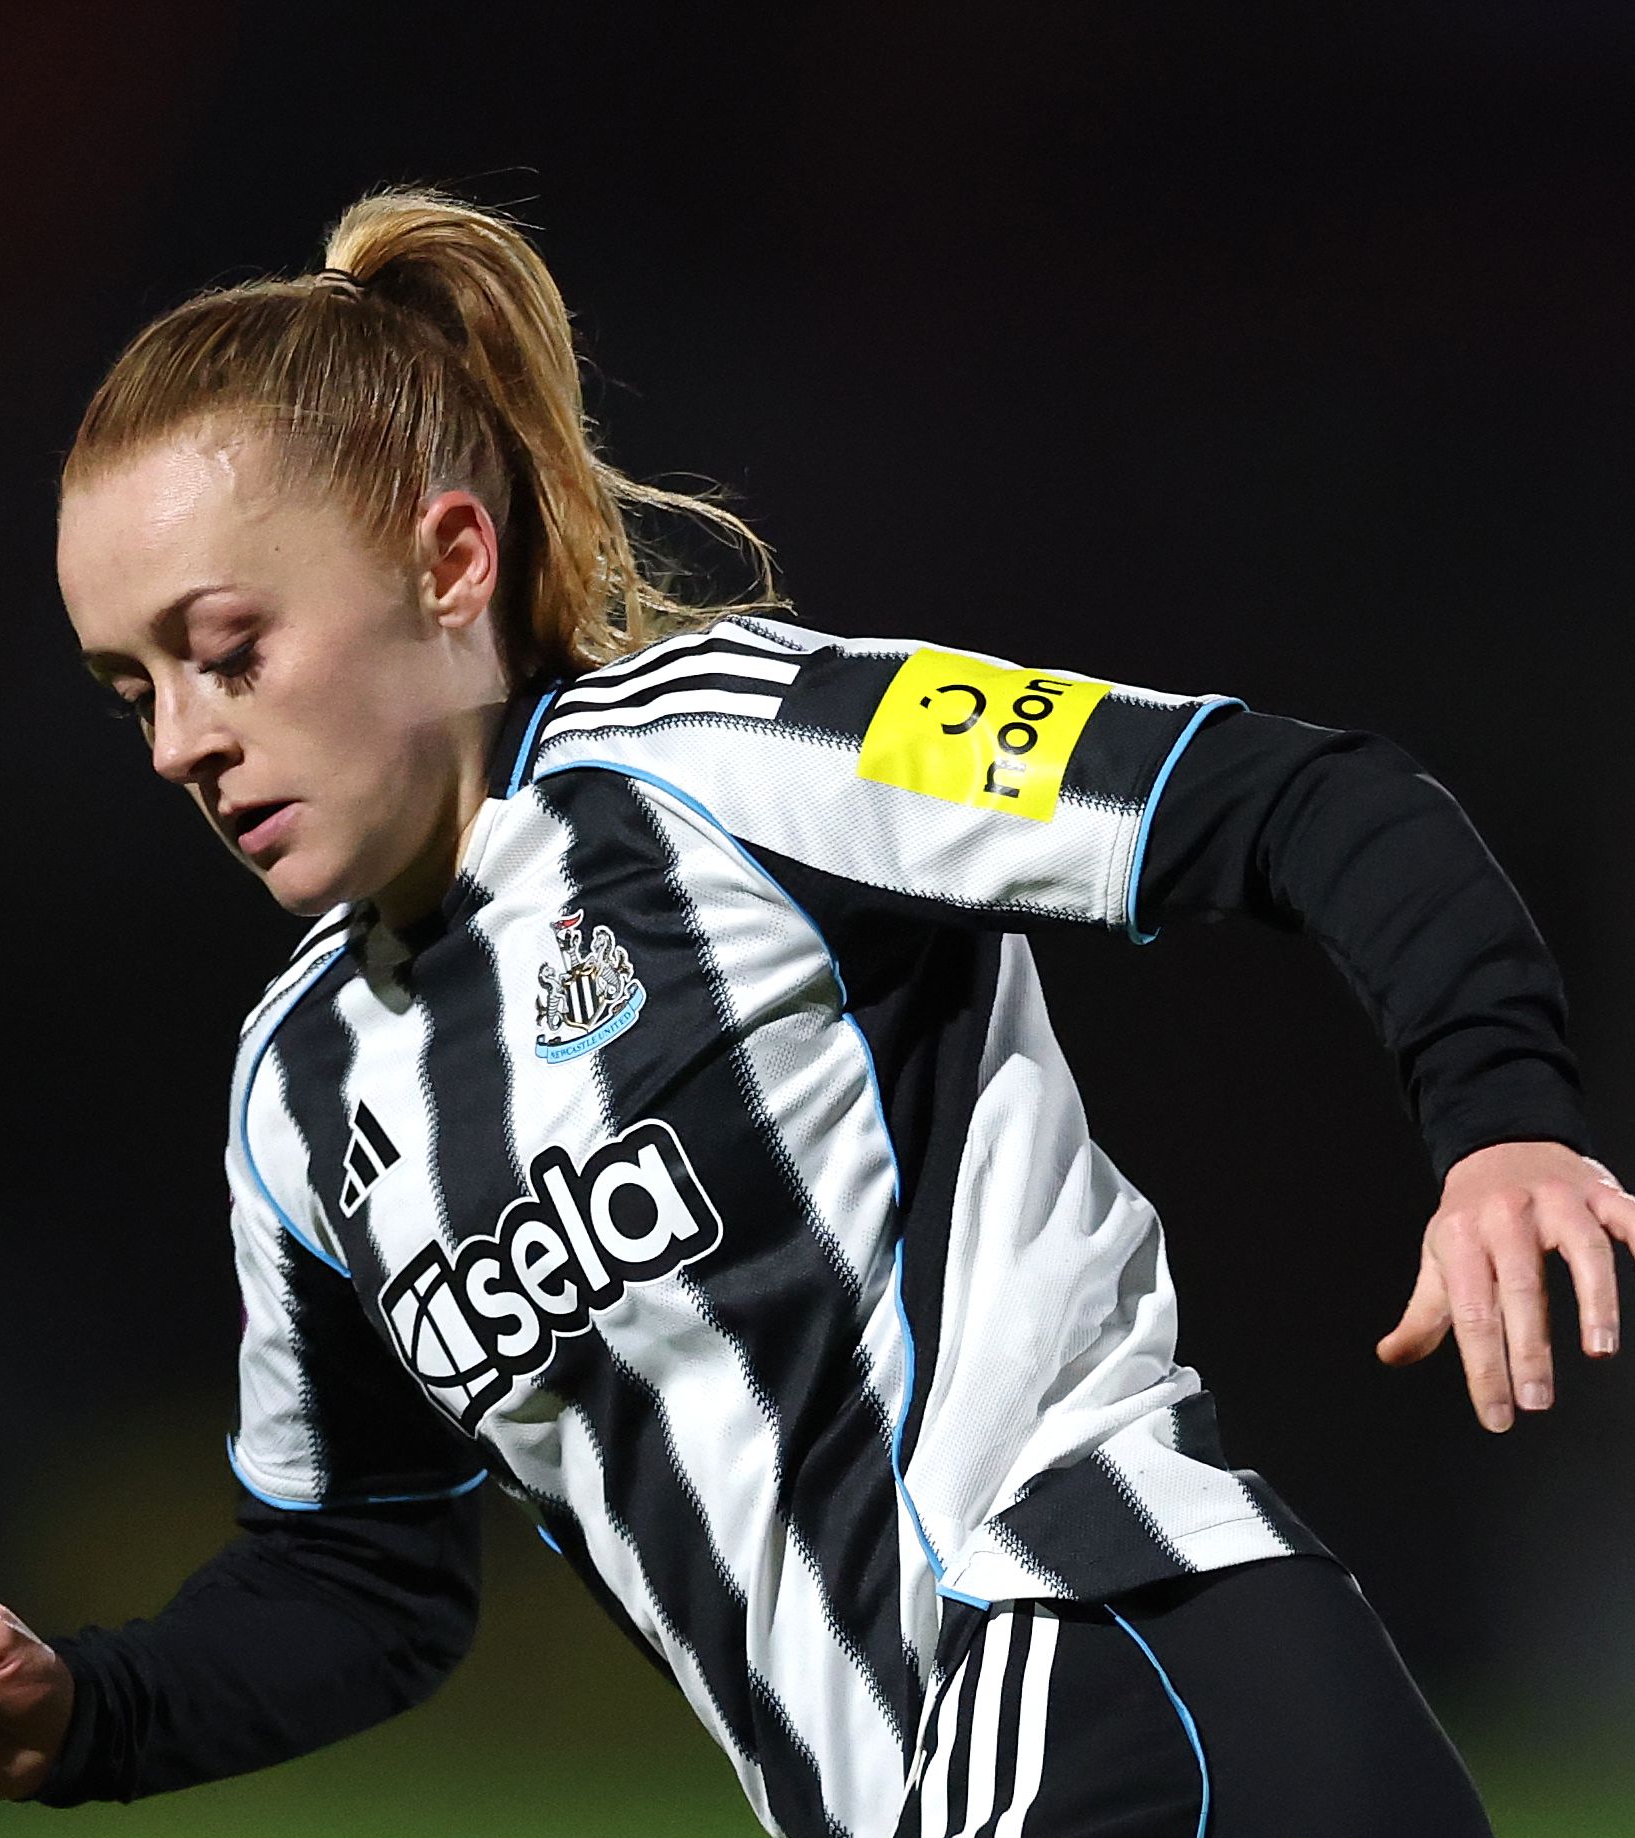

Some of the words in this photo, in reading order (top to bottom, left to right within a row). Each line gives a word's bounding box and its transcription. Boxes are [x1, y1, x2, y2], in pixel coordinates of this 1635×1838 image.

[982, 678, 1074, 799] noon
[550, 1035, 598, 1059] NEWCASTLE
[598, 1011, 632, 1040] UNITED
